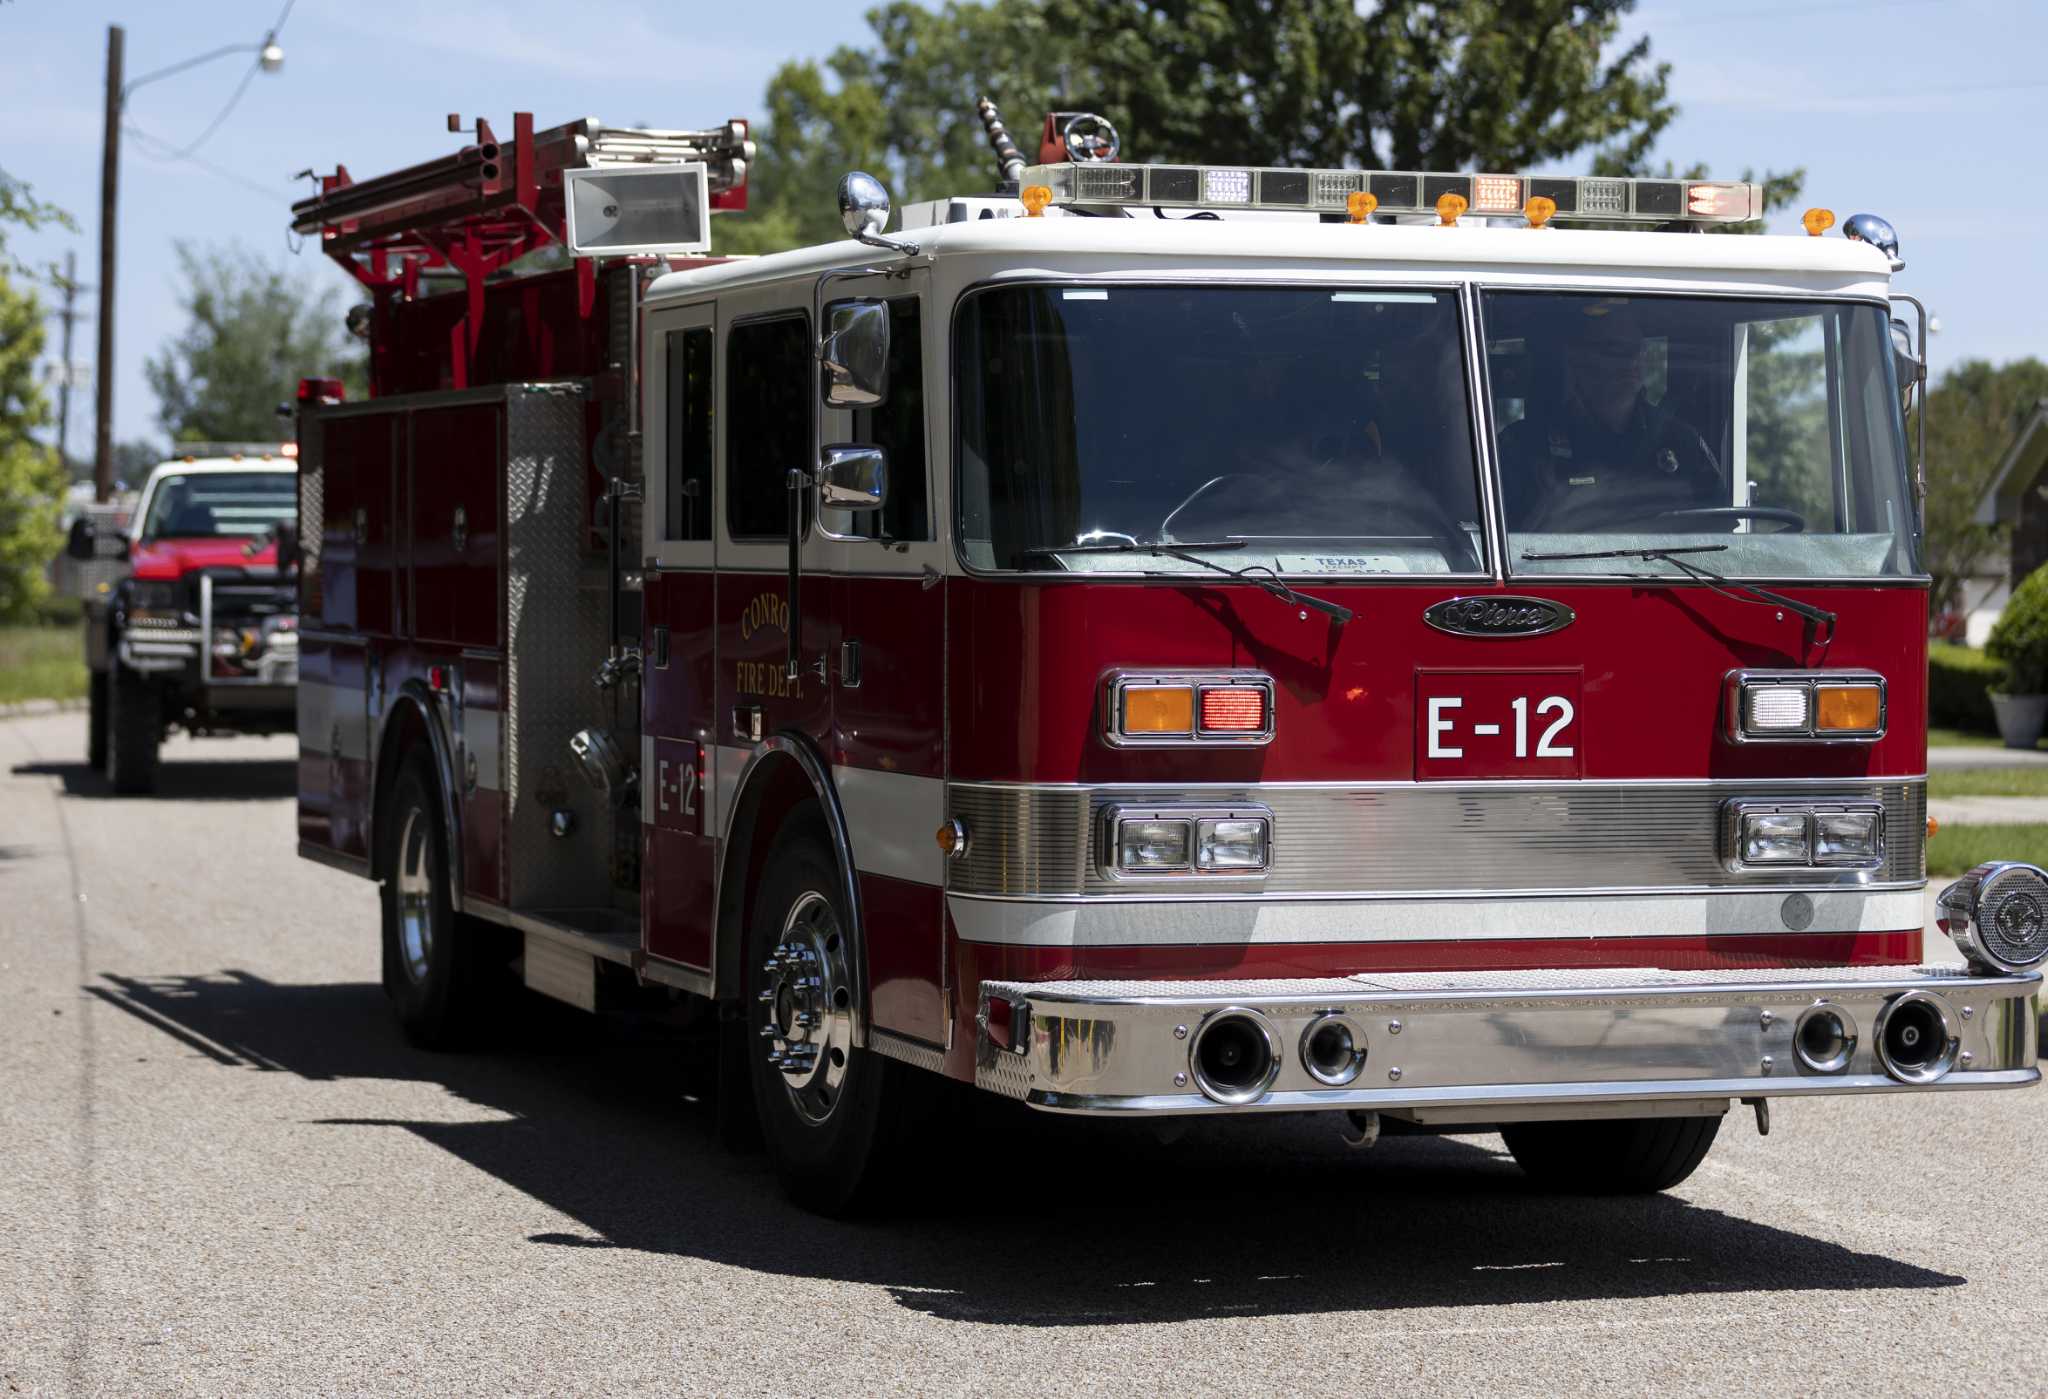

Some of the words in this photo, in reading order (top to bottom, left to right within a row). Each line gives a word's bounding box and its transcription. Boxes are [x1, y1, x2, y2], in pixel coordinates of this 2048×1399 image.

[1315, 558, 1367, 566] TEXAS
[742, 592, 789, 640] CONRO
[1461, 600, 1542, 630] Pierce
[736, 661, 765, 695] FIRE
[1428, 696, 1574, 758] E-12
[660, 760, 695, 815] E-12
